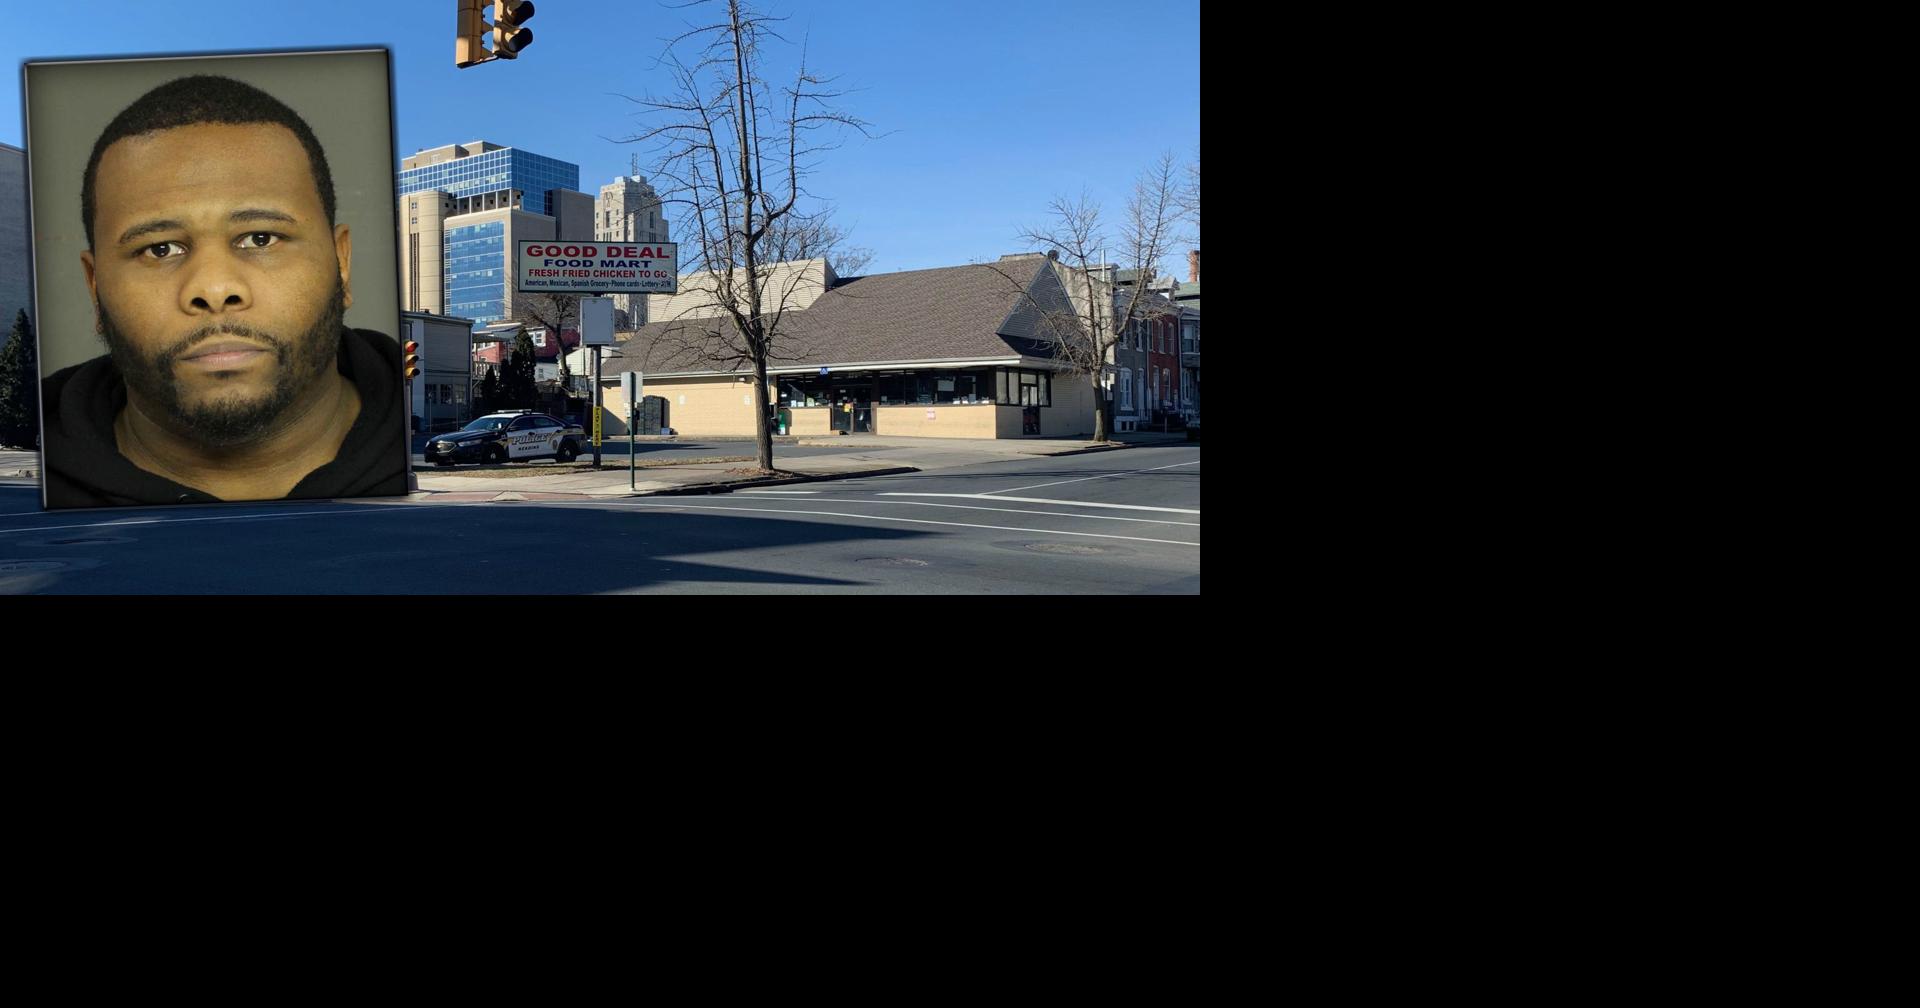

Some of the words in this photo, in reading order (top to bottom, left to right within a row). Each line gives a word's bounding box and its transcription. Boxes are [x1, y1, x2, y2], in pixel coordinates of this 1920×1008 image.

[527, 245, 598, 257] GOOD
[607, 246, 670, 258] DEAL
[544, 259, 594, 267] FOOD
[600, 260, 652, 268] MART
[529, 269, 560, 277] FRESH
[562, 269, 590, 277] FRIED
[593, 270, 635, 278] CHICKEN
[639, 270, 651, 278] TO
[571, 280, 589, 288] Spanish
[510, 433, 548, 445] POLICE
